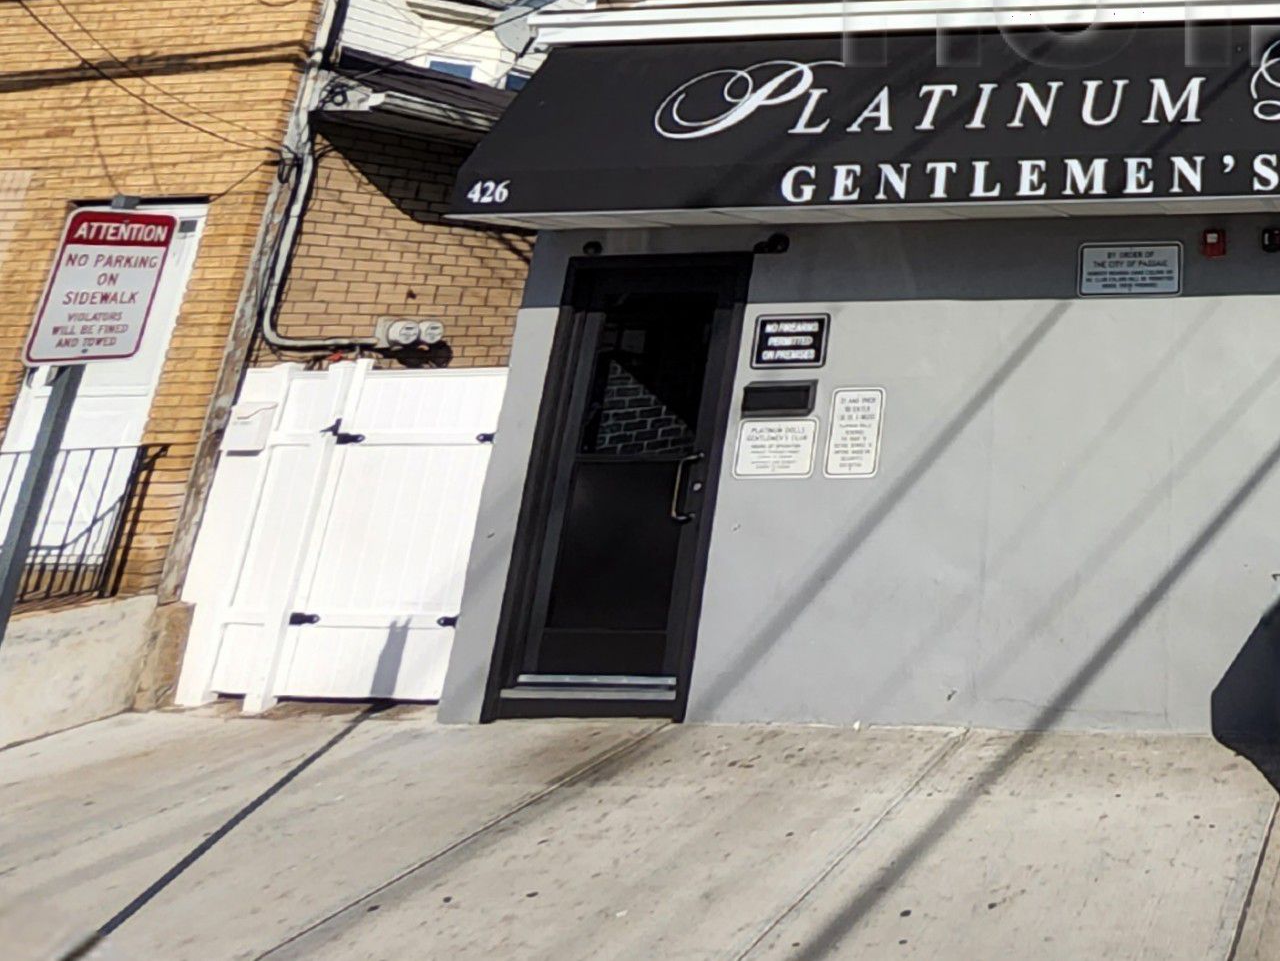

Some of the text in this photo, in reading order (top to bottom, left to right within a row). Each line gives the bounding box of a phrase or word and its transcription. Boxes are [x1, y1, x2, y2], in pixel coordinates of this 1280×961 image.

[655, 60, 1206, 139] PLATINUM
[781, 154, 1280, 203] GENTLEMEN'S
[466, 179, 511, 204] 426
[74, 221, 169, 242] ATTENTION
[65, 253, 159, 269] NO PARKING
[97, 273, 120, 286] ON
[62, 291, 139, 306] SIDEWALK
[67, 311, 124, 322] VIOLATORS
[52, 323, 129, 336] WILL BE FINED
[55, 337, 117, 348] AND TOWED
